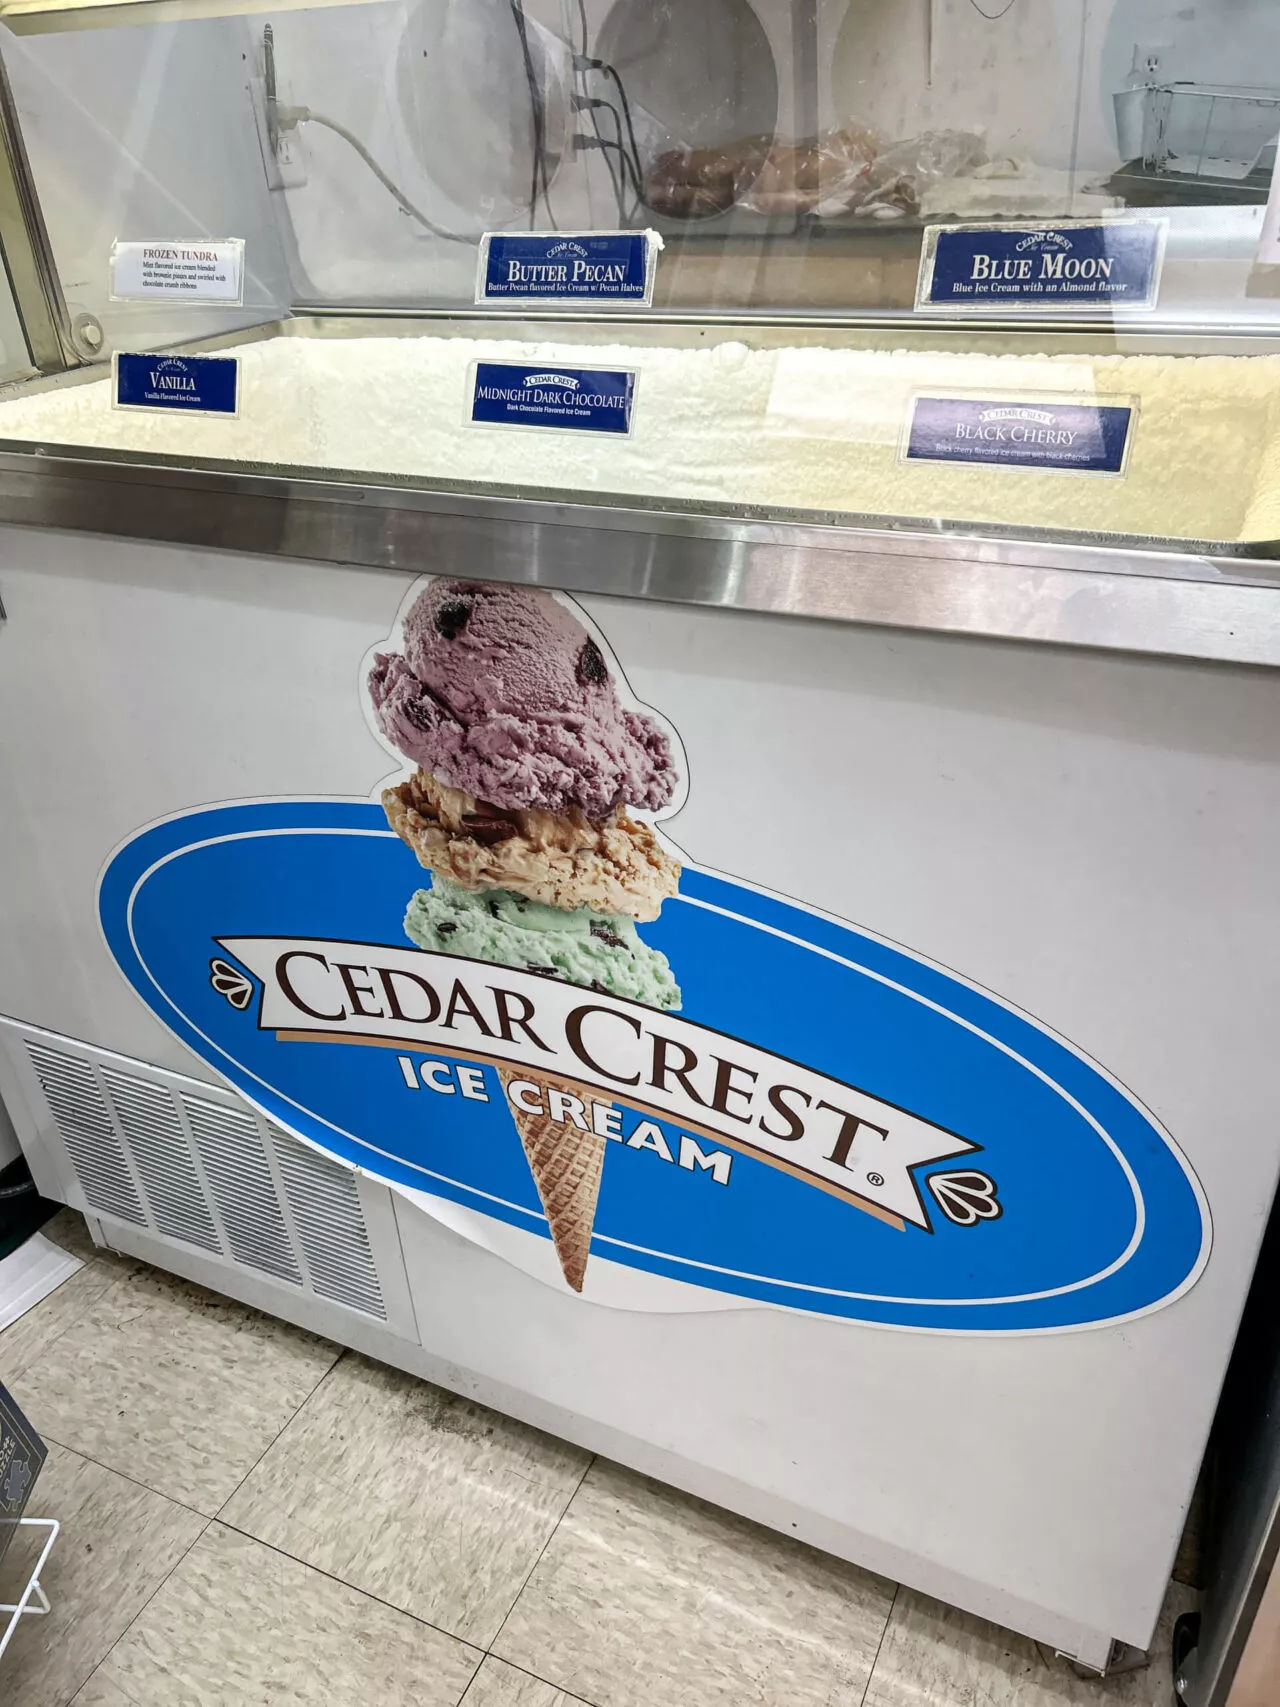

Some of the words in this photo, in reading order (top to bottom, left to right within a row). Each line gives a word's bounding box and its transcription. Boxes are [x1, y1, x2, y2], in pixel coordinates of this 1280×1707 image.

[1015, 232, 1045, 252] CEDAR
[1047, 231, 1074, 251] CREST
[144, 249, 179, 260] FROZEN
[180, 251, 218, 262] TUNDRA
[546, 242, 568, 259] CEDAR
[568, 241, 588, 258] CREST
[154, 262, 174, 270] flavored
[507, 260, 568, 282] BUTTER
[571, 260, 626, 282] PECAN
[970, 254, 1032, 280] BLUE
[1038, 253, 1114, 280] MOON
[488, 282, 508, 291] Butter
[509, 282, 528, 291] Pecan
[529, 282, 555, 292] flavored
[556, 282, 567, 291] Ice
[567, 283, 589, 292] Cream
[599, 283, 619, 292] Pecan
[621, 283, 643, 292] Halves
[952, 282, 973, 293] Blue
[974, 282, 988, 293] Ice
[990, 282, 1020, 293] Cream
[1022, 282, 1044, 292] with
[1045, 284, 1058, 292] an
[1059, 282, 1096, 292] Almond
[1098, 282, 1127, 292] flavor
[150, 372, 196, 391] VANILLA
[528, 375, 552, 385] CEDAR
[552, 375, 575, 388] CREST
[145, 392, 160, 400] Vanilla
[160, 393, 179, 401] Flavored
[478, 385, 532, 403] MIDNIGHT
[533, 389, 562, 404] DARK
[563, 391, 625, 409] CHOCOLATE
[507, 403, 518, 411] Dark
[519, 404, 543, 413] Chocolate
[544, 406, 565, 414] Flavored
[566, 407, 574, 415] Ice
[574, 408, 591, 416] Cream
[987, 408, 1018, 419] CEDAR
[1019, 409, 1048, 422] CREST
[955, 423, 1007, 441] BLACK
[1010, 426, 1078, 446] CHERRY
[953, 444, 973, 456] cherry
[275, 950, 558, 1055] CEDAR
[564, 1004, 890, 1172] CREST
[397, 1055, 490, 1103] ICE
[507, 1078, 734, 1187] CREAM
